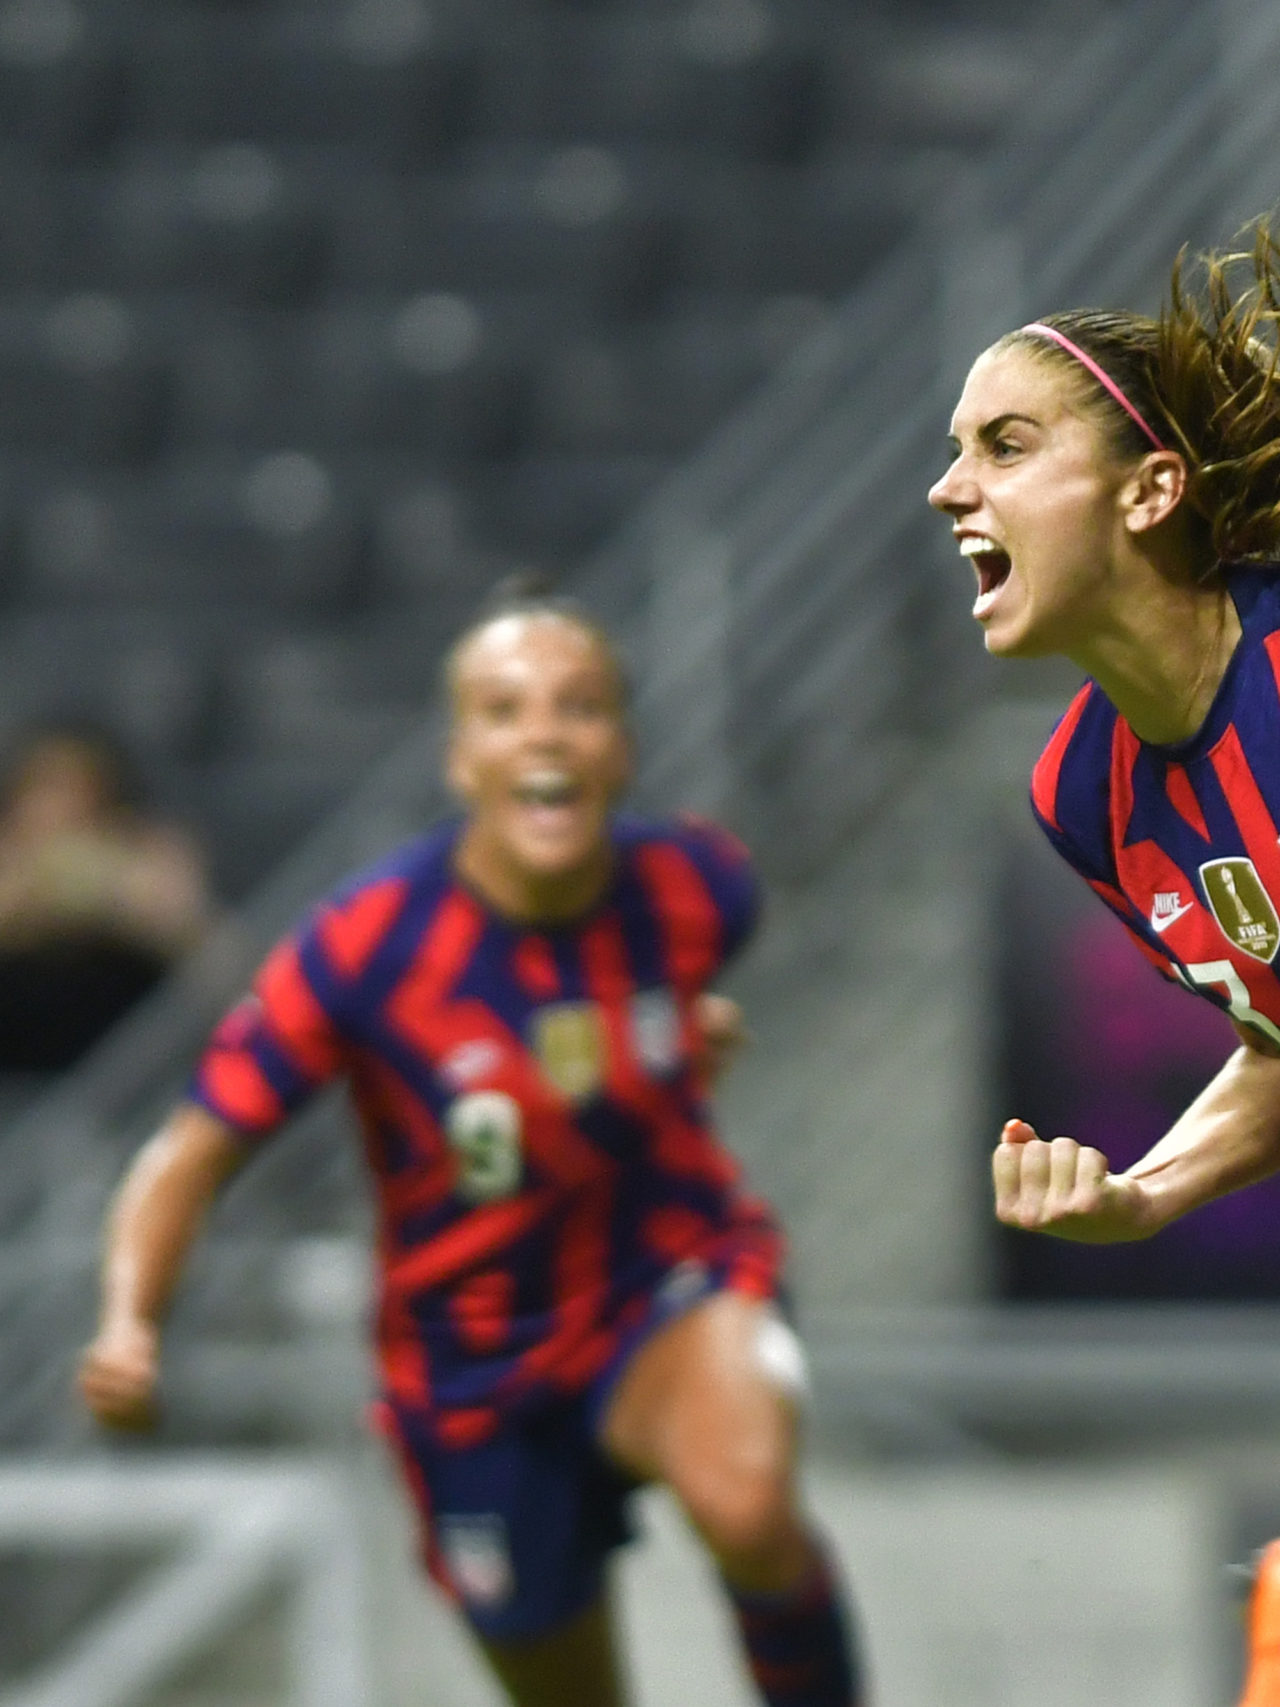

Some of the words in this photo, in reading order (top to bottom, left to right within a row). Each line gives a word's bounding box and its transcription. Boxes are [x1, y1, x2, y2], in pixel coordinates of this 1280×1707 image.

[1154, 892, 1180, 914] NIKE
[1238, 923, 1267, 938] FIFA
[447, 1090, 521, 1200] 9
